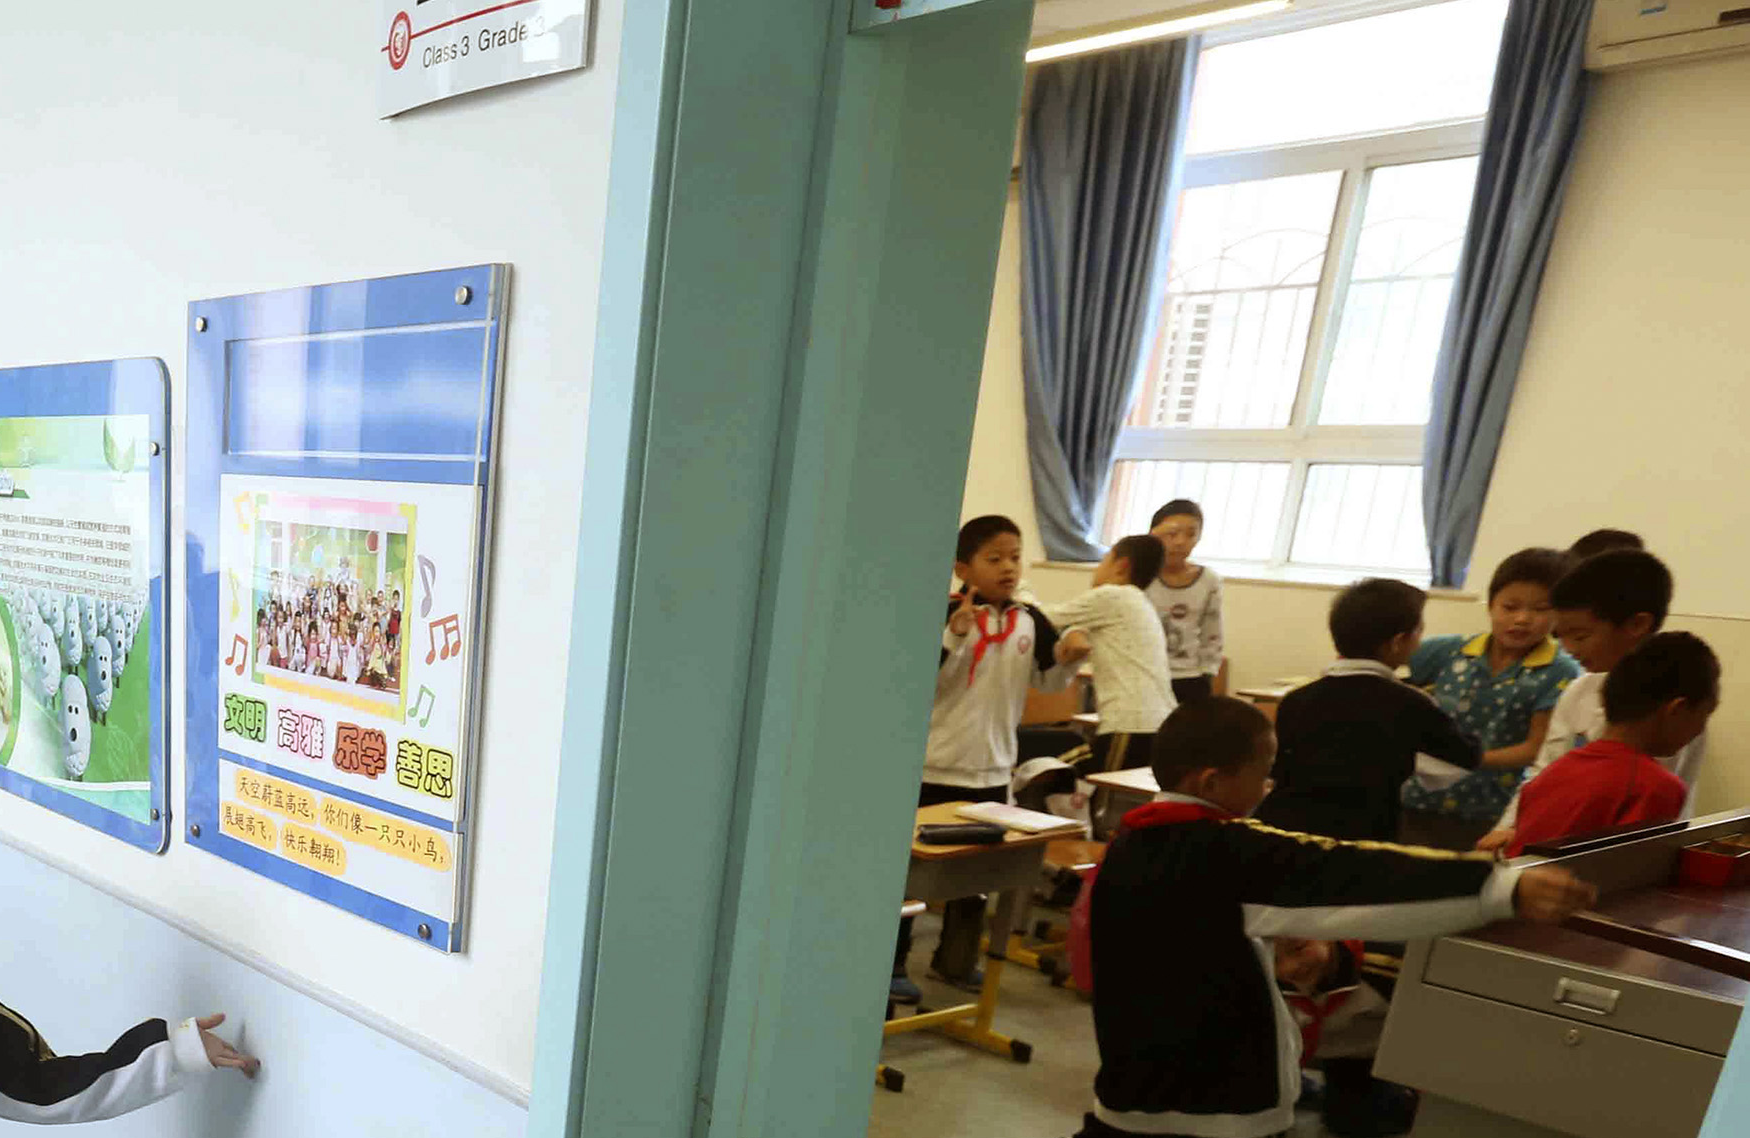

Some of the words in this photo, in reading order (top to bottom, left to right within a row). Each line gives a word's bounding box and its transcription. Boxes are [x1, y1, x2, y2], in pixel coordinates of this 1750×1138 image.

[422, 43, 457, 68] Class
[461, 36, 470, 56] 3
[479, 23, 527, 51] Grade
[224, 694, 268, 743] 文明
[277, 709, 325, 760] 高雅
[334, 724, 388, 778] 乐学
[395, 739, 453, 799] 善思
